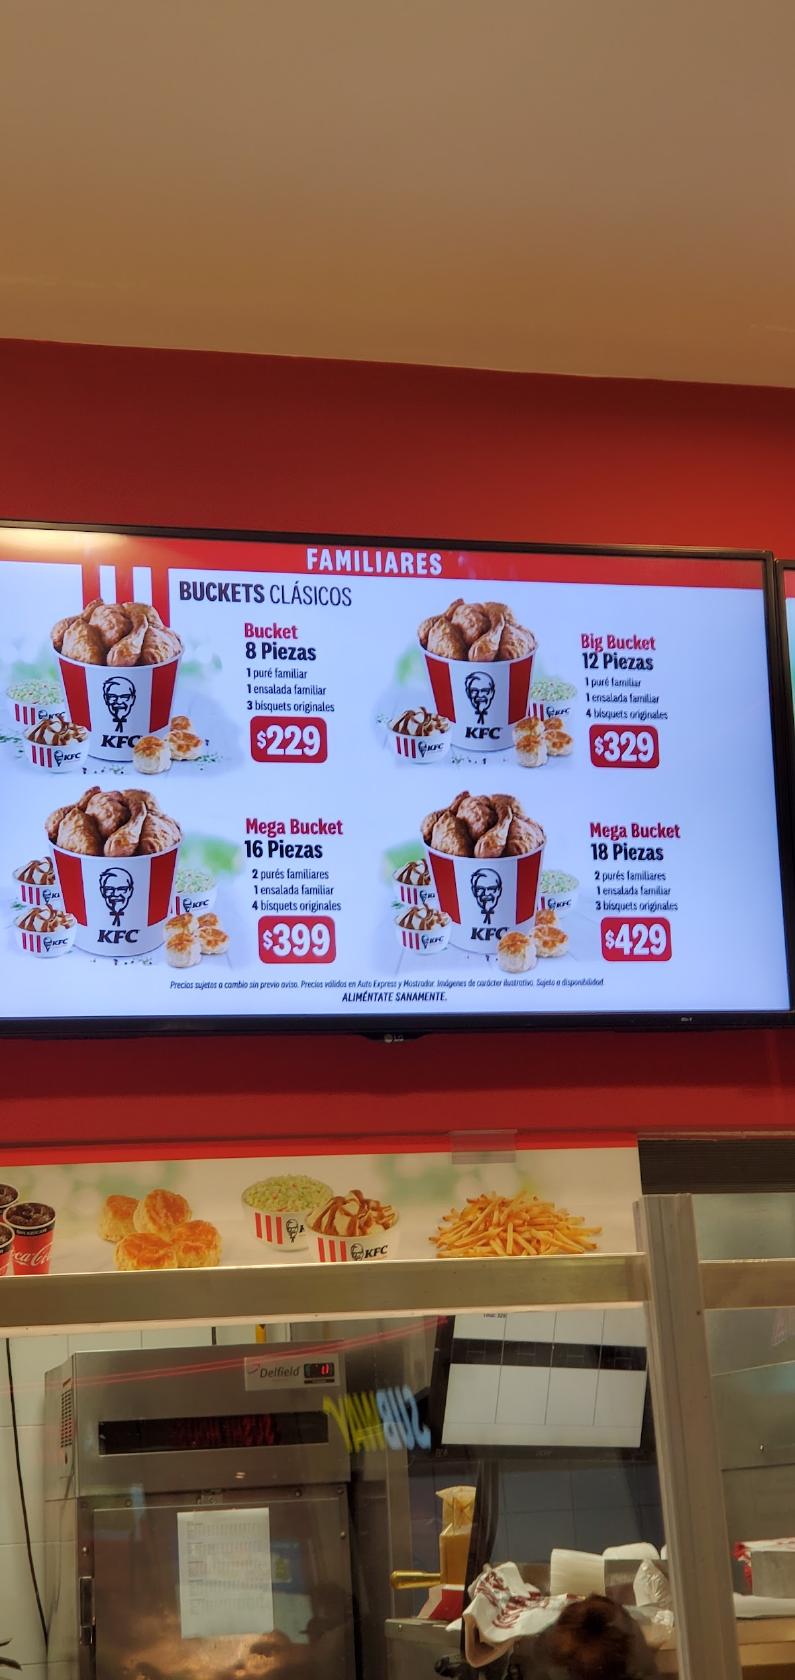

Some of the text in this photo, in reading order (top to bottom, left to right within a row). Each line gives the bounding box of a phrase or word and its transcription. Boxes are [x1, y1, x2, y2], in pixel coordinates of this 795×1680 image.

[306, 547, 442, 576] FAMILIARES
[179, 580, 352, 606] BUCKETS CLÁSICOS
[244, 622, 298, 639] Bucket
[580, 633, 657, 653] Big Bucket
[245, 641, 317, 661] 8 Piezas
[582, 652, 654, 671] 12 Piezas
[246, 667, 308, 680] 1 puré familiar
[585, 677, 642, 688] 1 puré familiar
[247, 683, 327, 696] 1 ensalada familiar
[586, 692, 660, 704] 1 ensalada familiar
[246, 700, 253, 711] 3
[293, 700, 335, 714] originales
[585, 708, 592, 718] 4
[629, 709, 668, 721] originales
[465, 726, 503, 740] KFC
[256, 724, 321, 757] $229
[427, 742, 445, 751] KFC
[594, 730, 655, 763] $329
[63, 752, 81, 761] KFC
[245, 817, 344, 838] Mega Bucket
[590, 822, 681, 841] Mega Bucket
[244, 839, 323, 859] 16 Piezas
[590, 842, 664, 861] 18 Piezas
[252, 868, 329, 881] 2 purés familiares
[594, 870, 667, 882] 2 purés familiares
[254, 884, 335, 896] 1 ensalada familiar
[597, 885, 671, 896] 1 ensalada familiar
[191, 899, 210, 909] KFC
[251, 900, 259, 911] 4
[299, 900, 342, 913] originales
[555, 899, 572, 908] KFC
[595, 900, 602, 911] 3
[639, 900, 679, 913] originales
[52, 937, 69, 946] KFC
[97, 929, 141, 944] KFC
[262, 922, 331, 957] $399
[605, 923, 667, 956] $429
[170, 980, 194, 989] Precios
[195, 980, 217, 990] sujetos
[224, 980, 249, 989] cambio
[249, 981, 259, 989] sin
[260, 981, 280, 990] previo
[300, 980, 324, 989] Precios
[357, 980, 372, 988] Auto
[373, 979, 397, 989] Express
[467, 979, 476, 987] de
[341, 990, 448, 1003] ALIMÉNTATE SANAMENTE.
[364, 1244, 388, 1259] KFC
[260, 1366, 300, 1378] Delfield
